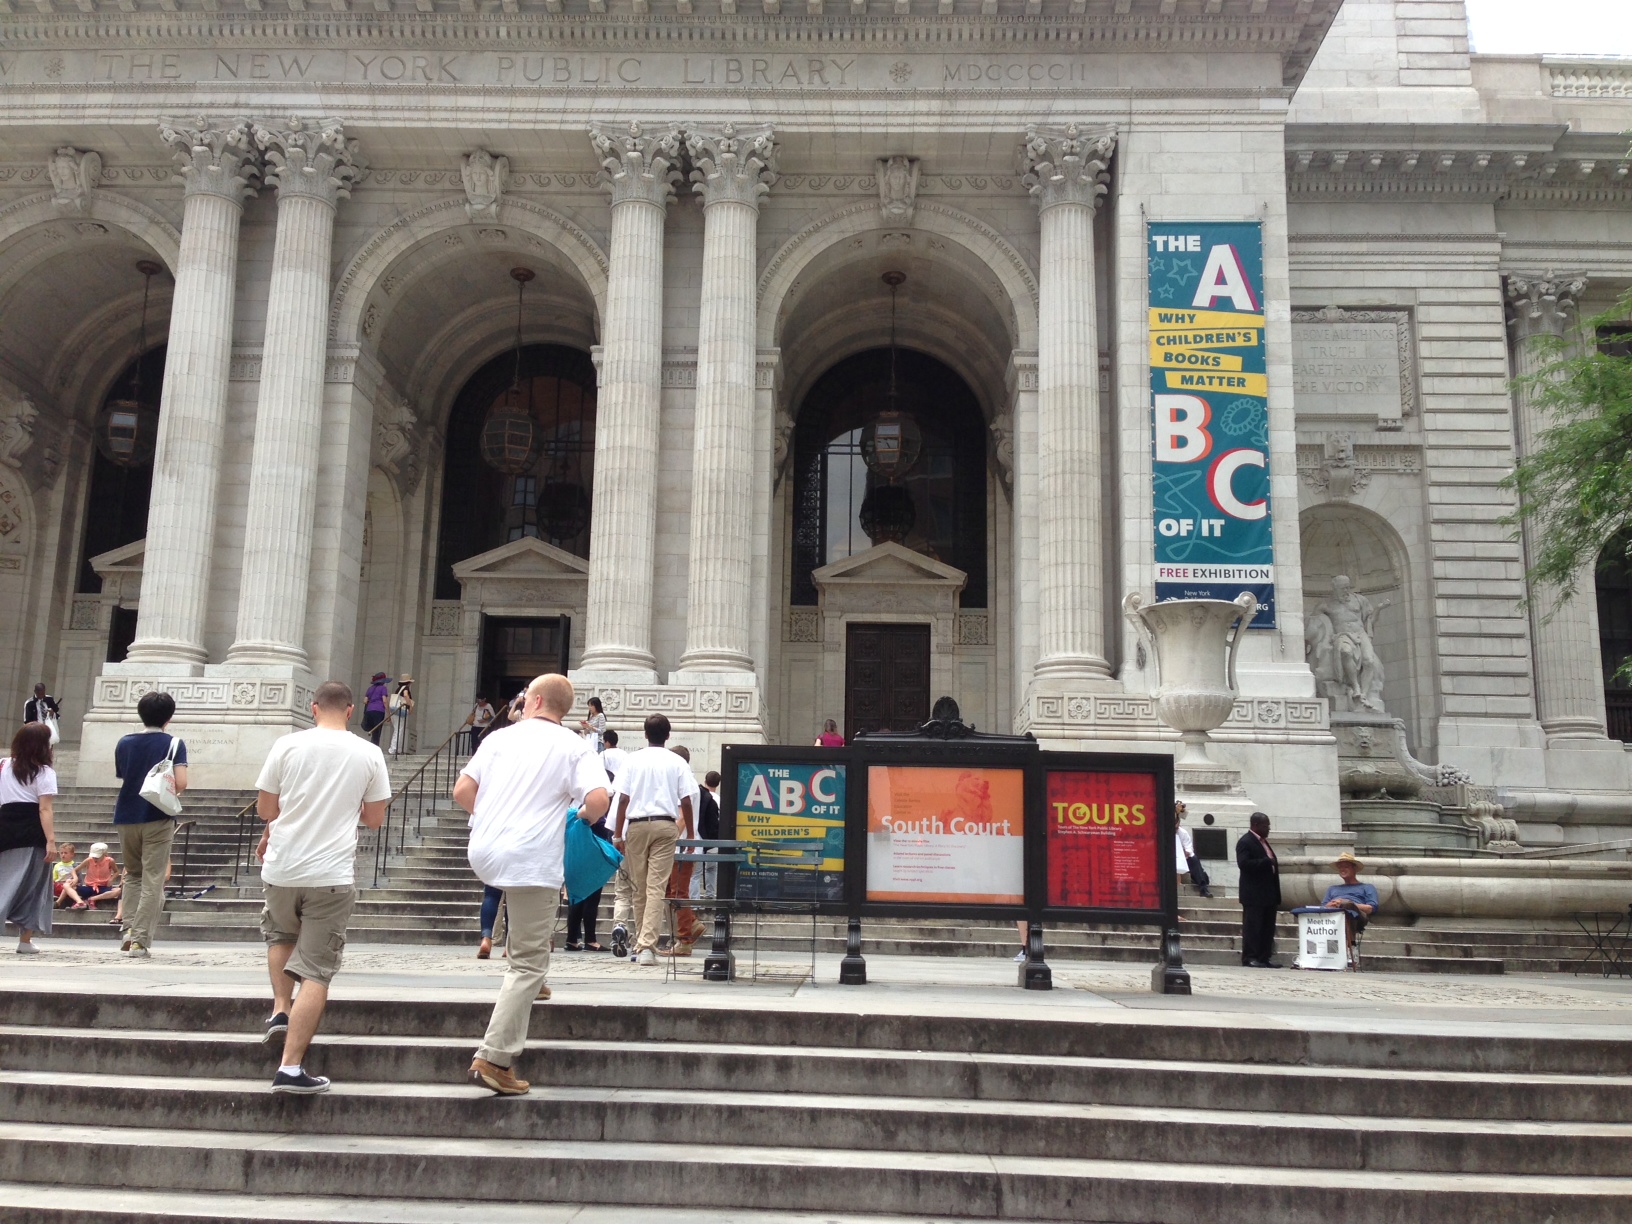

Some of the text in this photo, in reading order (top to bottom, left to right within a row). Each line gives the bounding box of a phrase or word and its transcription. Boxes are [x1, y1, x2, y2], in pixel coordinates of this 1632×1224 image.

[101, 53, 855, 85] THE NEW YORK PUBLIC LIBRARY
[943, 63, 1086, 82] MDCCCCII
[1152, 235, 1201, 252] THE
[1192, 243, 1260, 311] A
[1158, 313, 1196, 323] WHY
[1156, 332, 1252, 346] CHILDREN'S
[1332, 329, 1351, 340] ALL
[1353, 330, 1394, 340] THINGS
[1310, 346, 1356, 358] TRUTH
[1164, 352, 1221, 366] BOOKS
[1293, 364, 1387, 375] EARETH AWAY
[1180, 374, 1246, 387] MATTER
[1322, 381, 1381, 393] VICTORY
[1154, 394, 1213, 463] B
[1206, 447, 1267, 520] C
[1158, 518, 1225, 537] OF IT
[1160, 567, 1270, 579] FREE EXHIBITION
[768, 768, 790, 778] THE
[811, 805, 840, 814] OF IT
[1052, 802, 1146, 825] TOURS
[747, 815, 771, 823] WHY
[881, 815, 1011, 836] South Court
[751, 828, 810, 837] CHILDREN'S
[1306, 927, 1338, 935] Author
